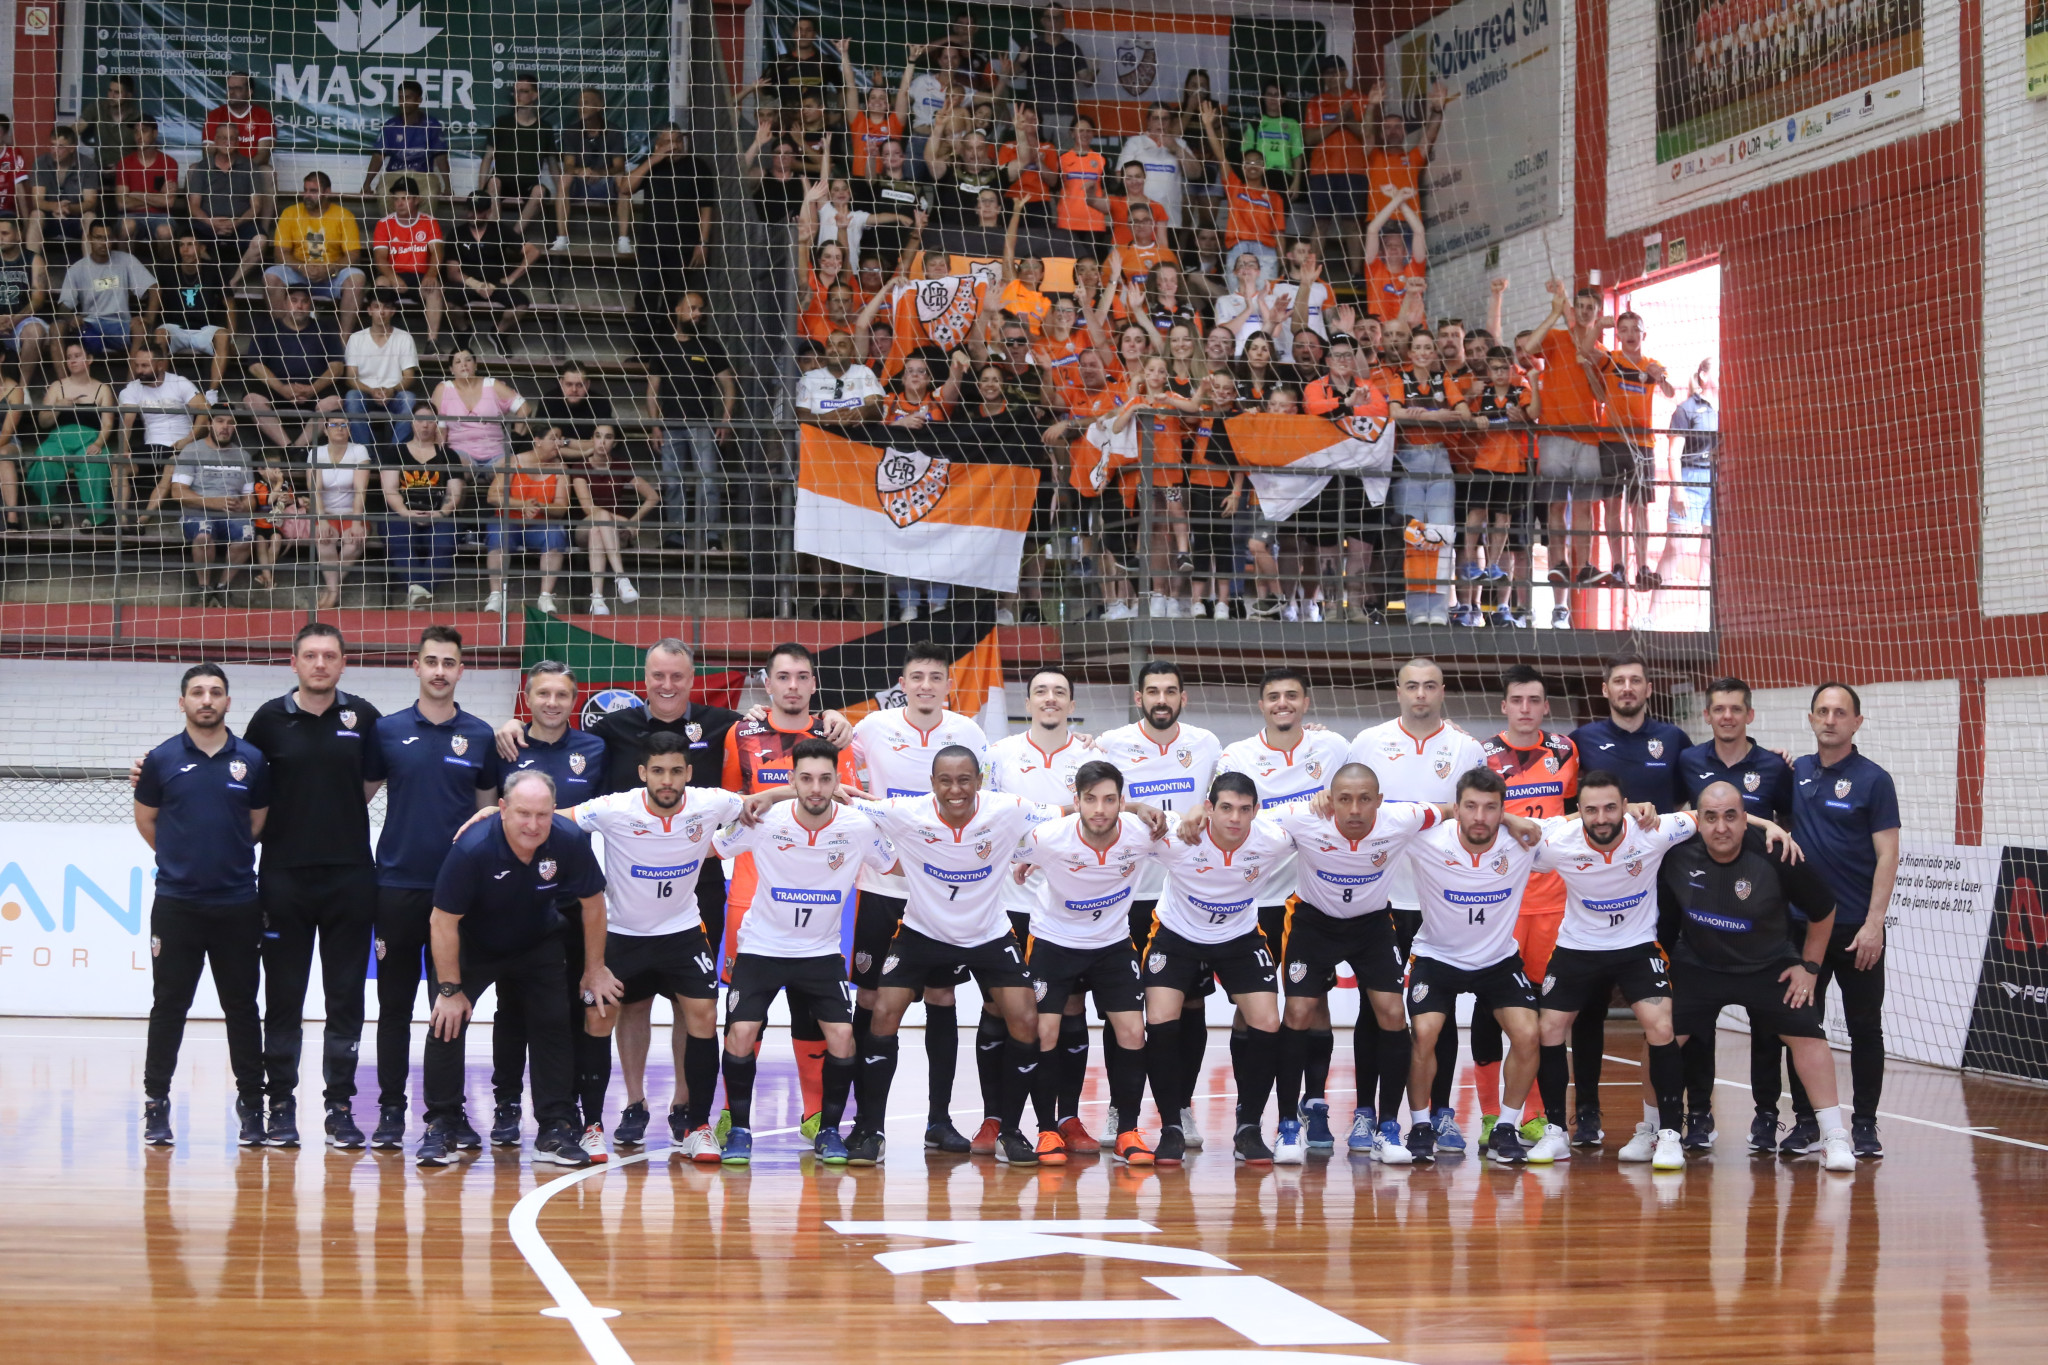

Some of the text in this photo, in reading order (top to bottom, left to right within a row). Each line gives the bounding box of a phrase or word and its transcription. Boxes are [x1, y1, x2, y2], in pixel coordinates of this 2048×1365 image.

[1430, 3, 1516, 84] Solucred
[274, 63, 477, 110] MASTER
[739, 726, 768, 737] CRESOL
[1545, 741, 1570, 751] CRESOL
[1134, 780, 1192, 794] TRAMONTINA
[1506, 785, 1560, 797] TRAMONTINA
[772, 834, 794, 843] CRESOL
[1372, 839, 1390, 847] CRESOL
[636, 863, 695, 878] TRAMONTINA
[1905, 854, 1943, 869] financiado
[1944, 856, 1961, 873] pelo
[929, 867, 988, 881] TRAMONTINA
[1321, 872, 1379, 884] TRAMONTINA
[657, 880, 673, 898] 16
[948, 884, 959, 901] 7
[1914, 876, 1923, 888] do
[1925, 875, 1953, 892] Esporte
[1961, 878, 1983, 893] Lazer
[776, 890, 836, 902] TRAMONTINA
[1071, 889, 1127, 910] TRAMONTINA
[1342, 888, 1353, 903] 8
[1449, 891, 1508, 903] TRAMONTINA
[1588, 895, 1644, 911] TRAMONTINA
[1193, 898, 1250, 914] TRAMONTINA
[1902, 894, 1911, 907] de
[1912, 896, 1940, 911] janeiro
[1941, 898, 1950, 911] de
[1952, 899, 1973, 915] 2012,
[795, 907, 813, 928] 17
[1092, 910, 1102, 921] 9
[1208, 912, 1227, 925] 12
[1468, 907, 1485, 925] 14
[1689, 911, 1746, 930] TRAMONTINA
[0, 946, 89, 969] FOR
[694, 951, 714, 974] 16
[1004, 945, 1020, 964] 7
[1254, 948, 1274, 967] 12
[1393, 945, 1402, 965] 8
[1131, 960, 1140, 980] 9
[1649, 957, 1665, 973] 10
[1512, 972, 1531, 989] 14
